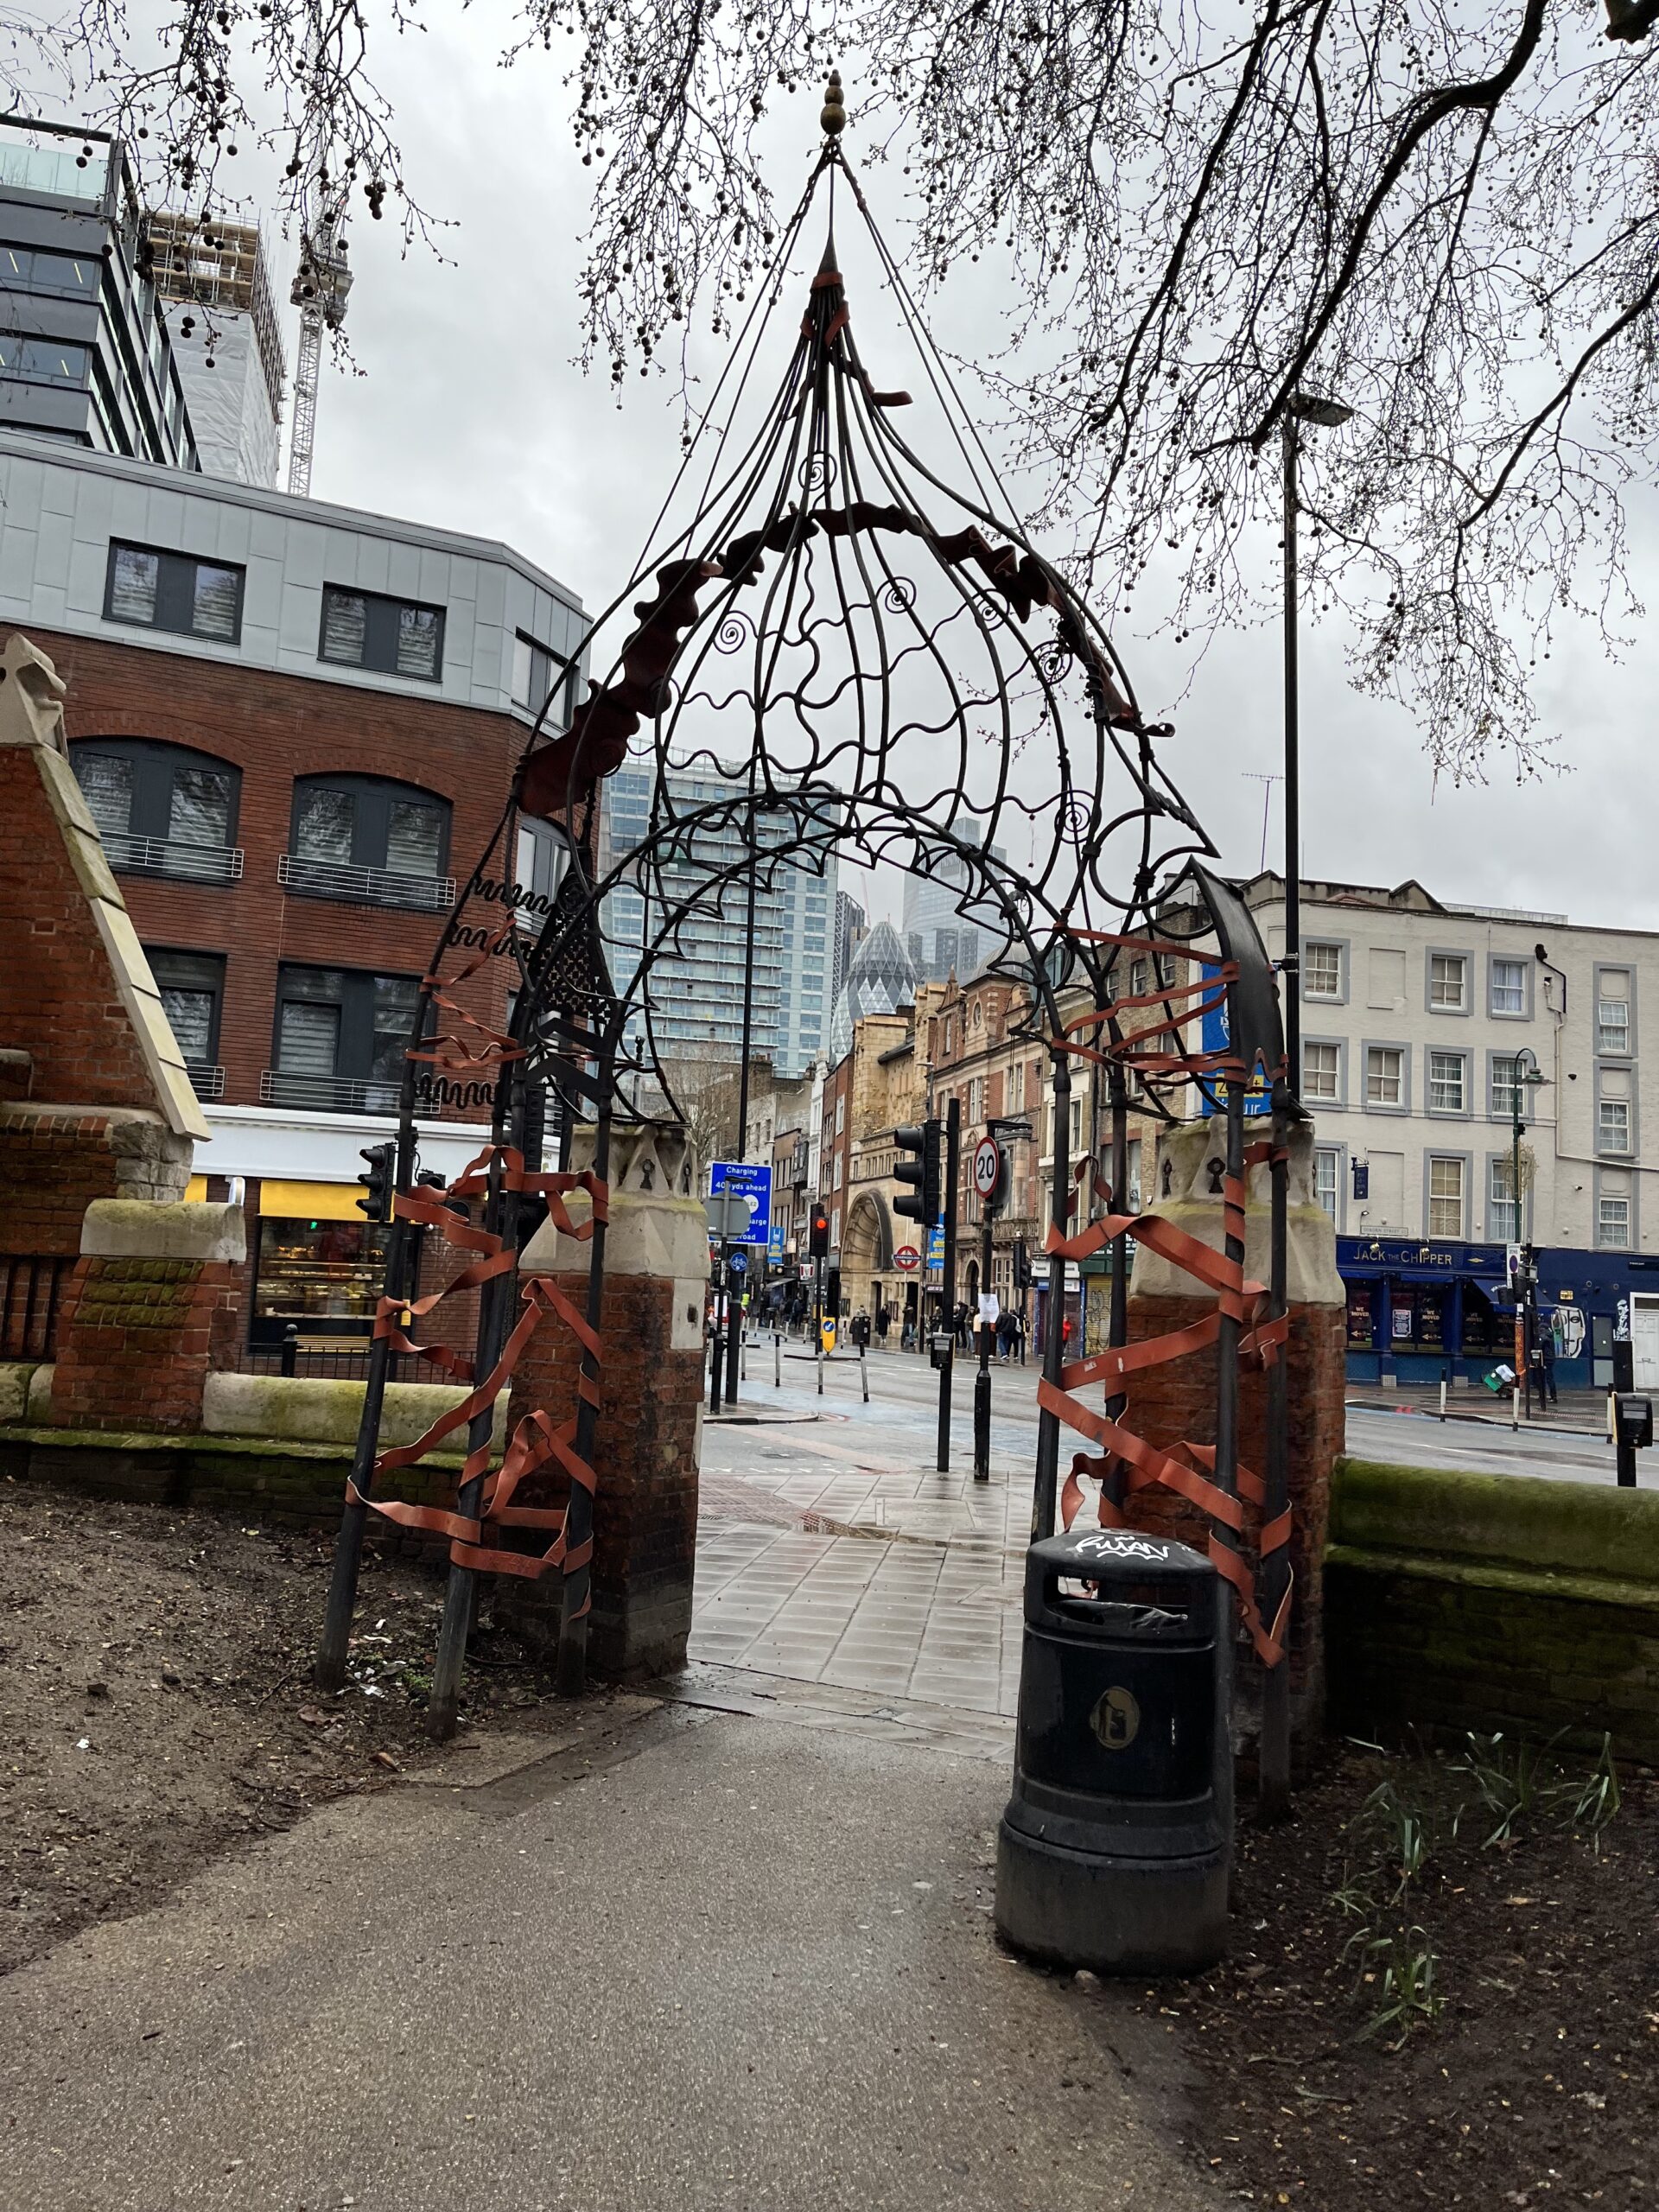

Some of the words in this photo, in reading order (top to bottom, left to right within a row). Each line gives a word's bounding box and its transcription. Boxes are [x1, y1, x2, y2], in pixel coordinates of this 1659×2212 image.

[726, 1166, 758, 1176] Charging
[977, 1154, 995, 1179] 20
[715, 1181, 731, 1190] 40
[1353, 1243, 1386, 1262] JACK
[1401, 1248, 1452, 1265] CHIPPER
